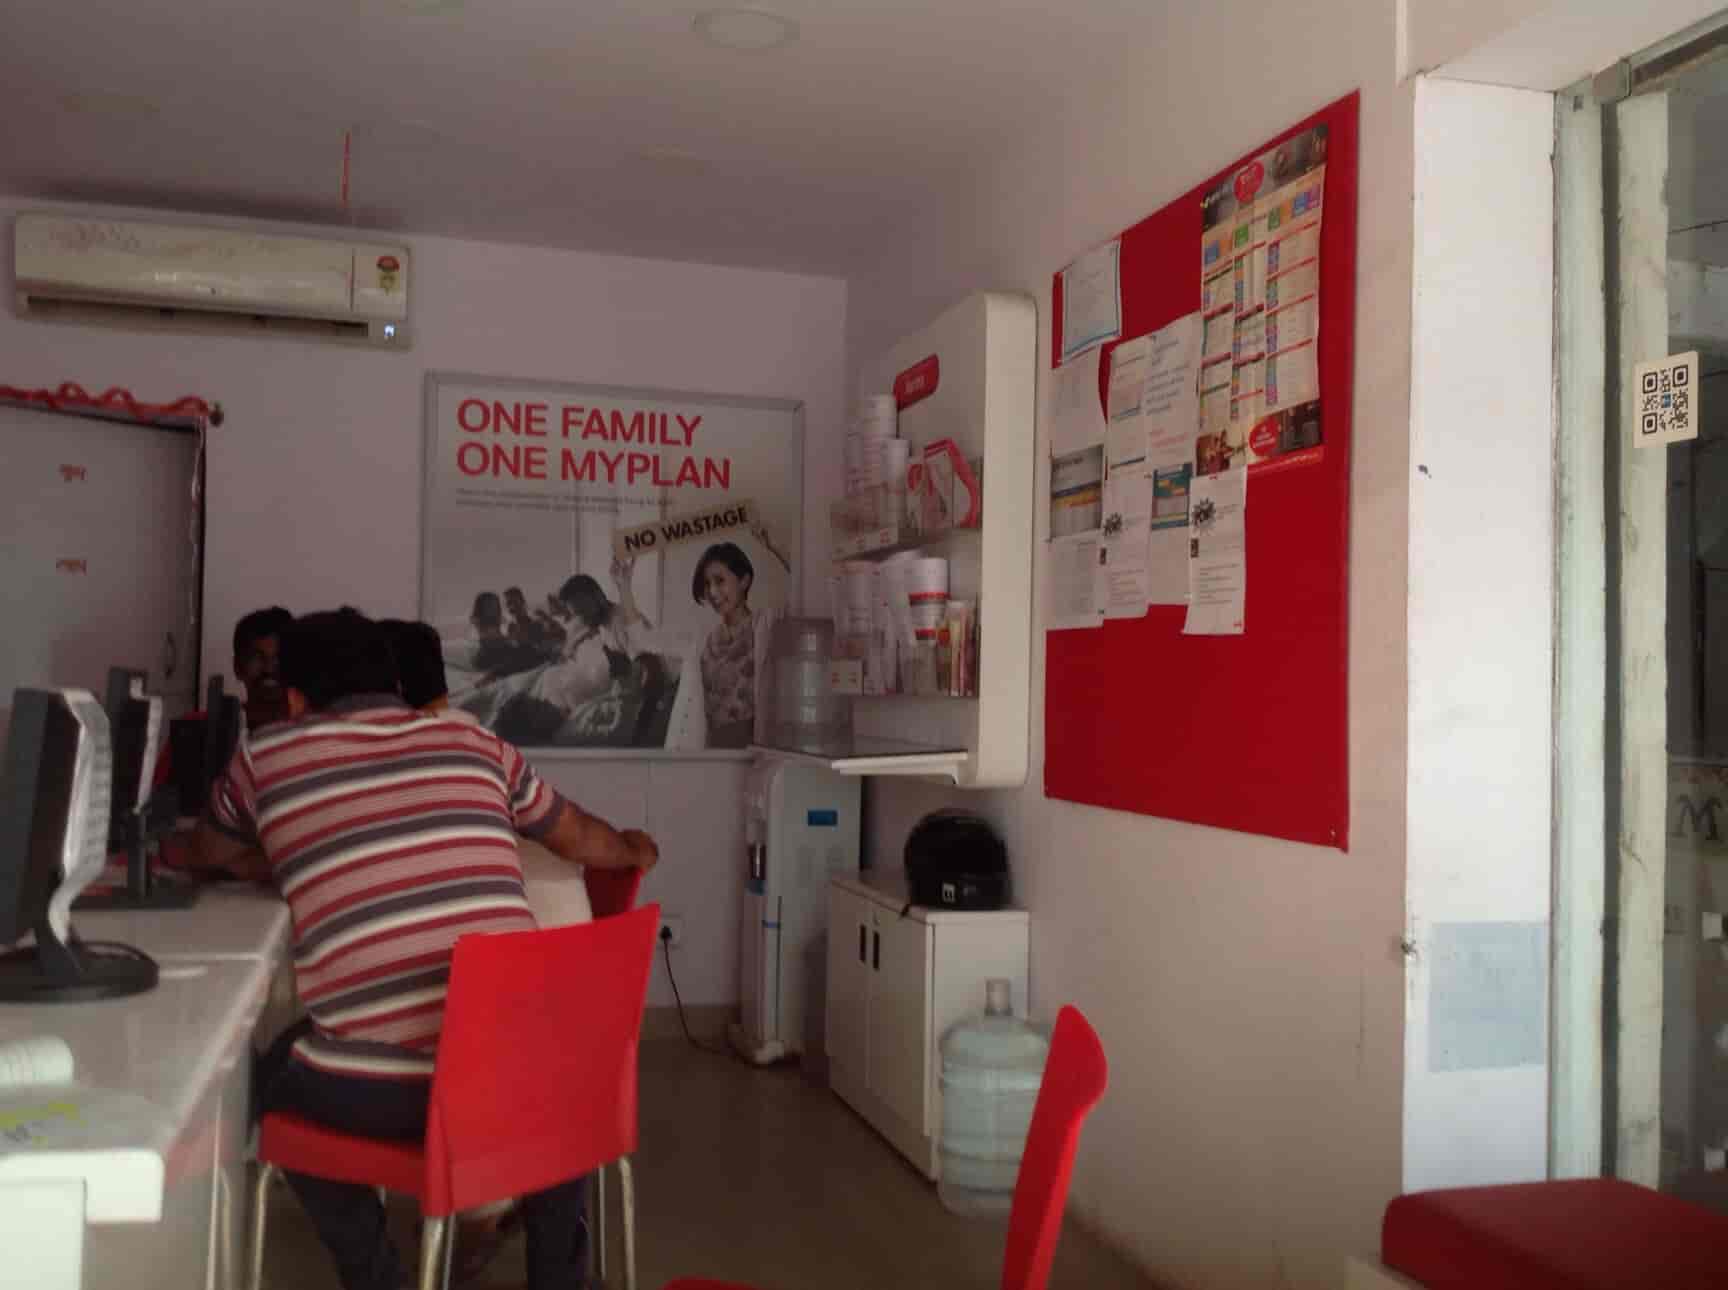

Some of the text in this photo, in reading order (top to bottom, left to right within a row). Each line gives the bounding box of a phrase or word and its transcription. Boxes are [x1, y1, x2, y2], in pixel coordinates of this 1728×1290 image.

[457, 398, 702, 447] ONE FAMILY
[456, 441, 732, 490] ONE MYPLAN
[624, 505, 749, 552] NO WASTAGE
